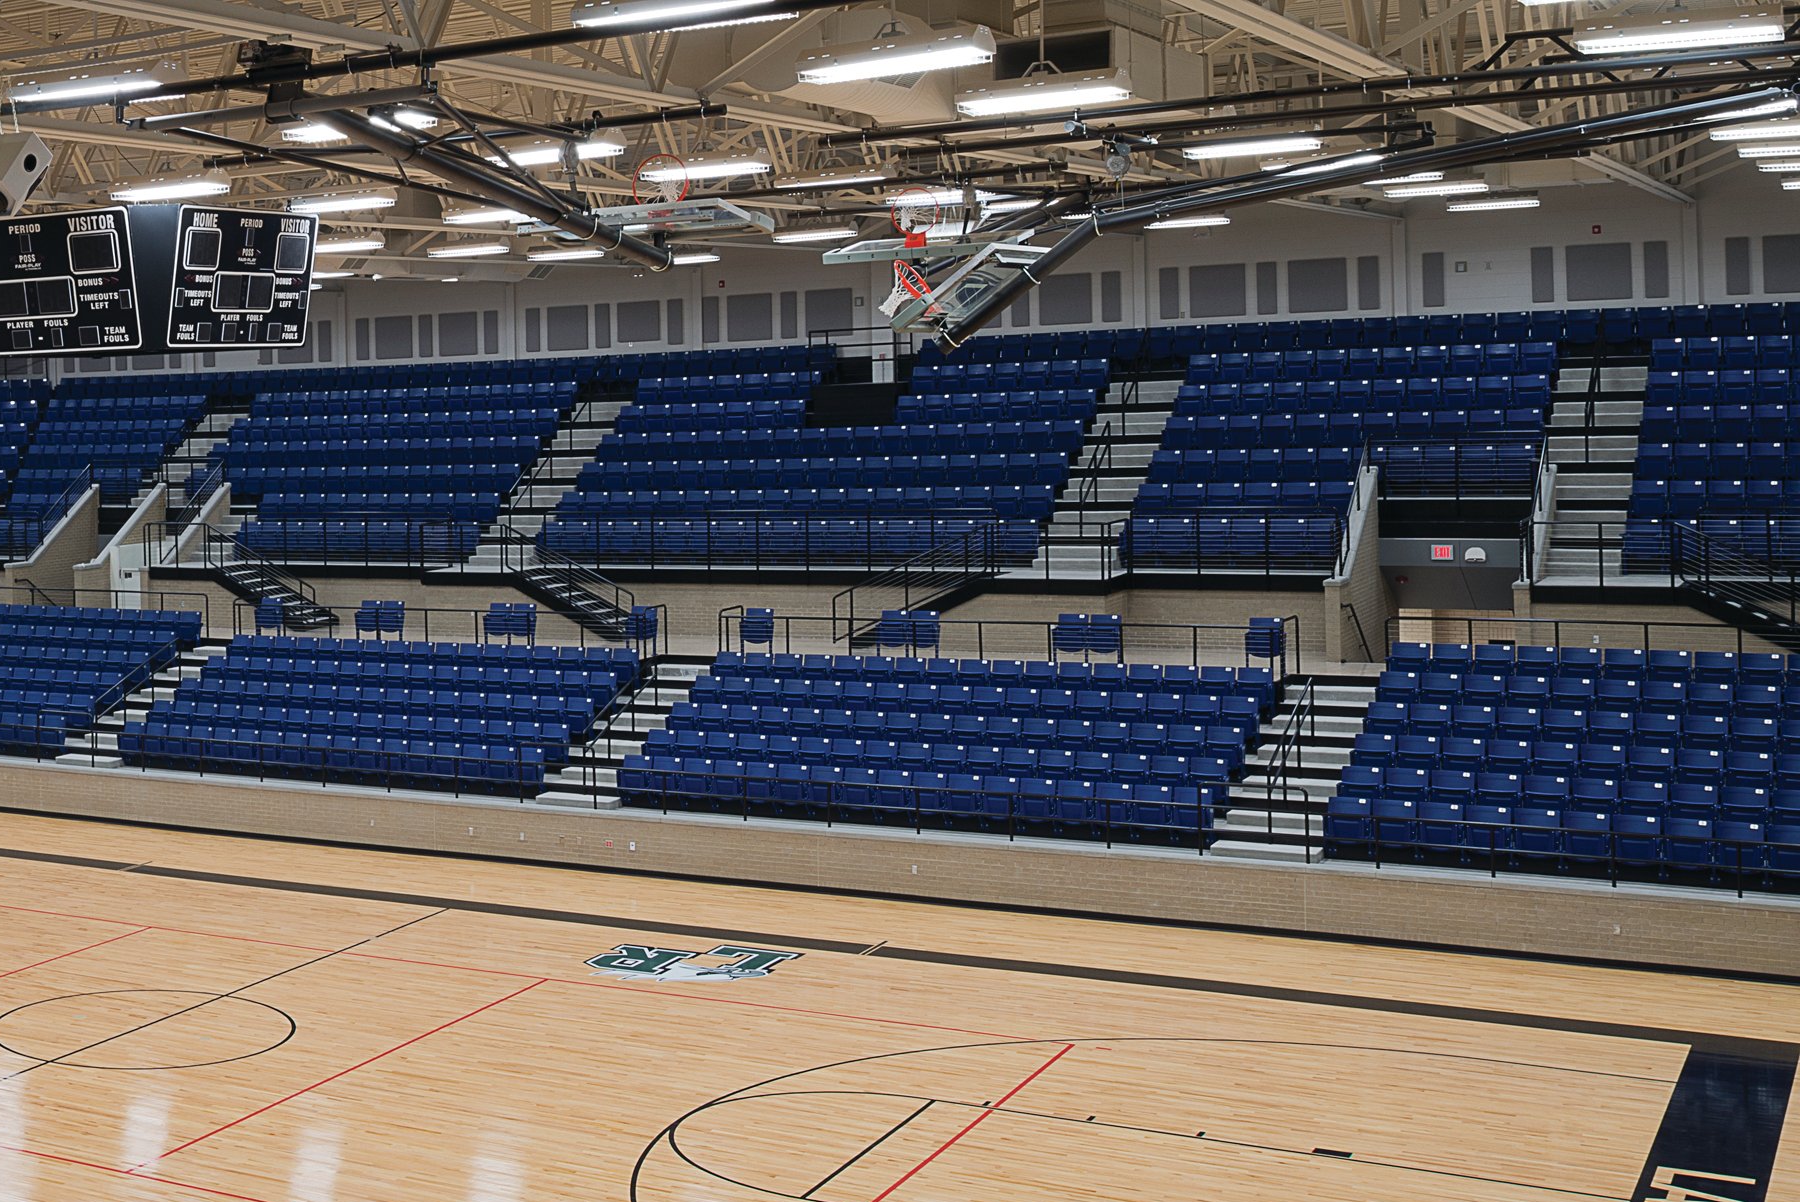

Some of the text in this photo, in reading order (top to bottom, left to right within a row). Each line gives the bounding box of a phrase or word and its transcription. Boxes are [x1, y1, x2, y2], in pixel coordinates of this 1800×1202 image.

[67, 214, 115, 232] VISITOR
[193, 212, 218, 228] HOME
[240, 218, 264, 228] PERIOD
[8, 224, 41, 235] PERIOD
[281, 218, 311, 234] VISITOR
[242, 248, 255, 256] POSS
[19, 254, 36, 263] POSS
[78, 278, 103, 287] BONUS
[195, 275, 213, 283] BONUS
[276, 277, 292, 285] BONUS
[79, 292, 119, 301] TIMEOUTS
[90, 301, 109, 309] LEFT
[7, 319, 68, 329] PLAYER FOULS
[104, 326, 126, 334] TEAM
[104, 334, 129, 342] FOULS
[1434, 546, 1451, 558] EXIT
